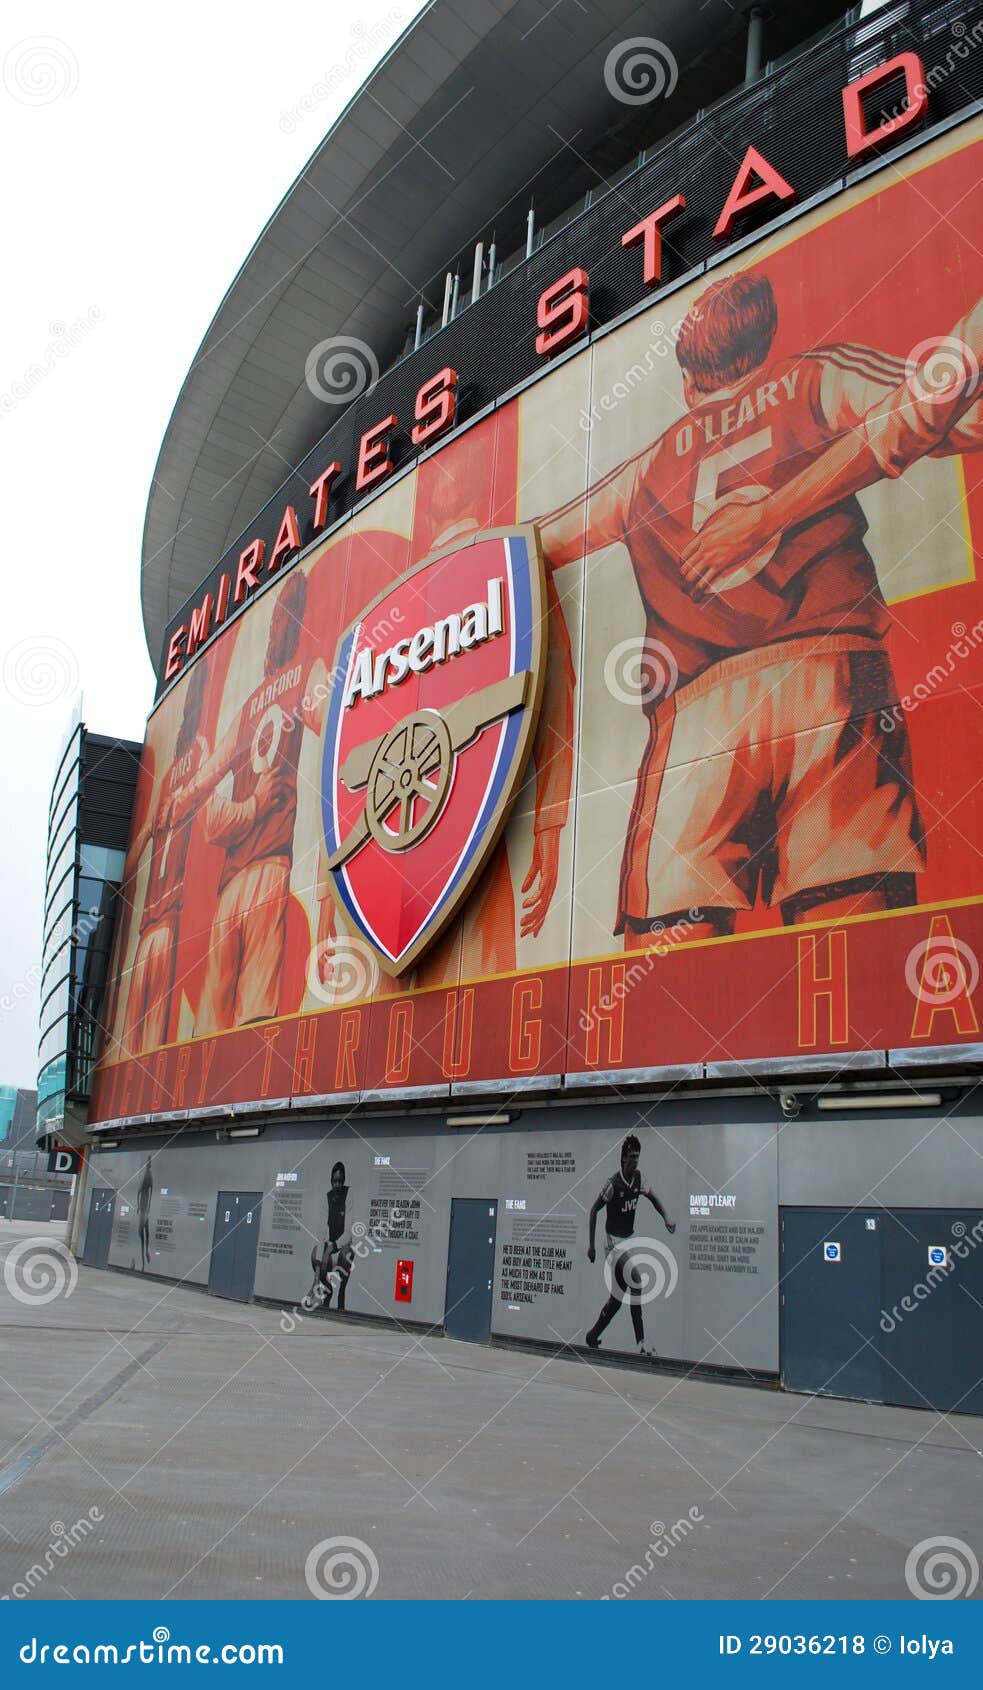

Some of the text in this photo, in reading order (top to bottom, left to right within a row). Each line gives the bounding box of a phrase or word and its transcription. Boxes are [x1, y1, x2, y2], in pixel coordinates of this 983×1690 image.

[164, 50, 928, 681] EMIRATES STAD
[676, 369, 800, 457] O'LEARY
[344, 576, 504, 709] Arsenal
[249, 665, 302, 719] RADFORD
[260, 963, 625, 1098] THROUGH
[797, 914, 980, 1047] HA
[54, 1151, 73, 1172] D
[690, 1195, 736, 1207] DAVID O'LEARY
[532, 1246, 541, 1256] THE
[542, 1247, 554, 1258] CLUB
